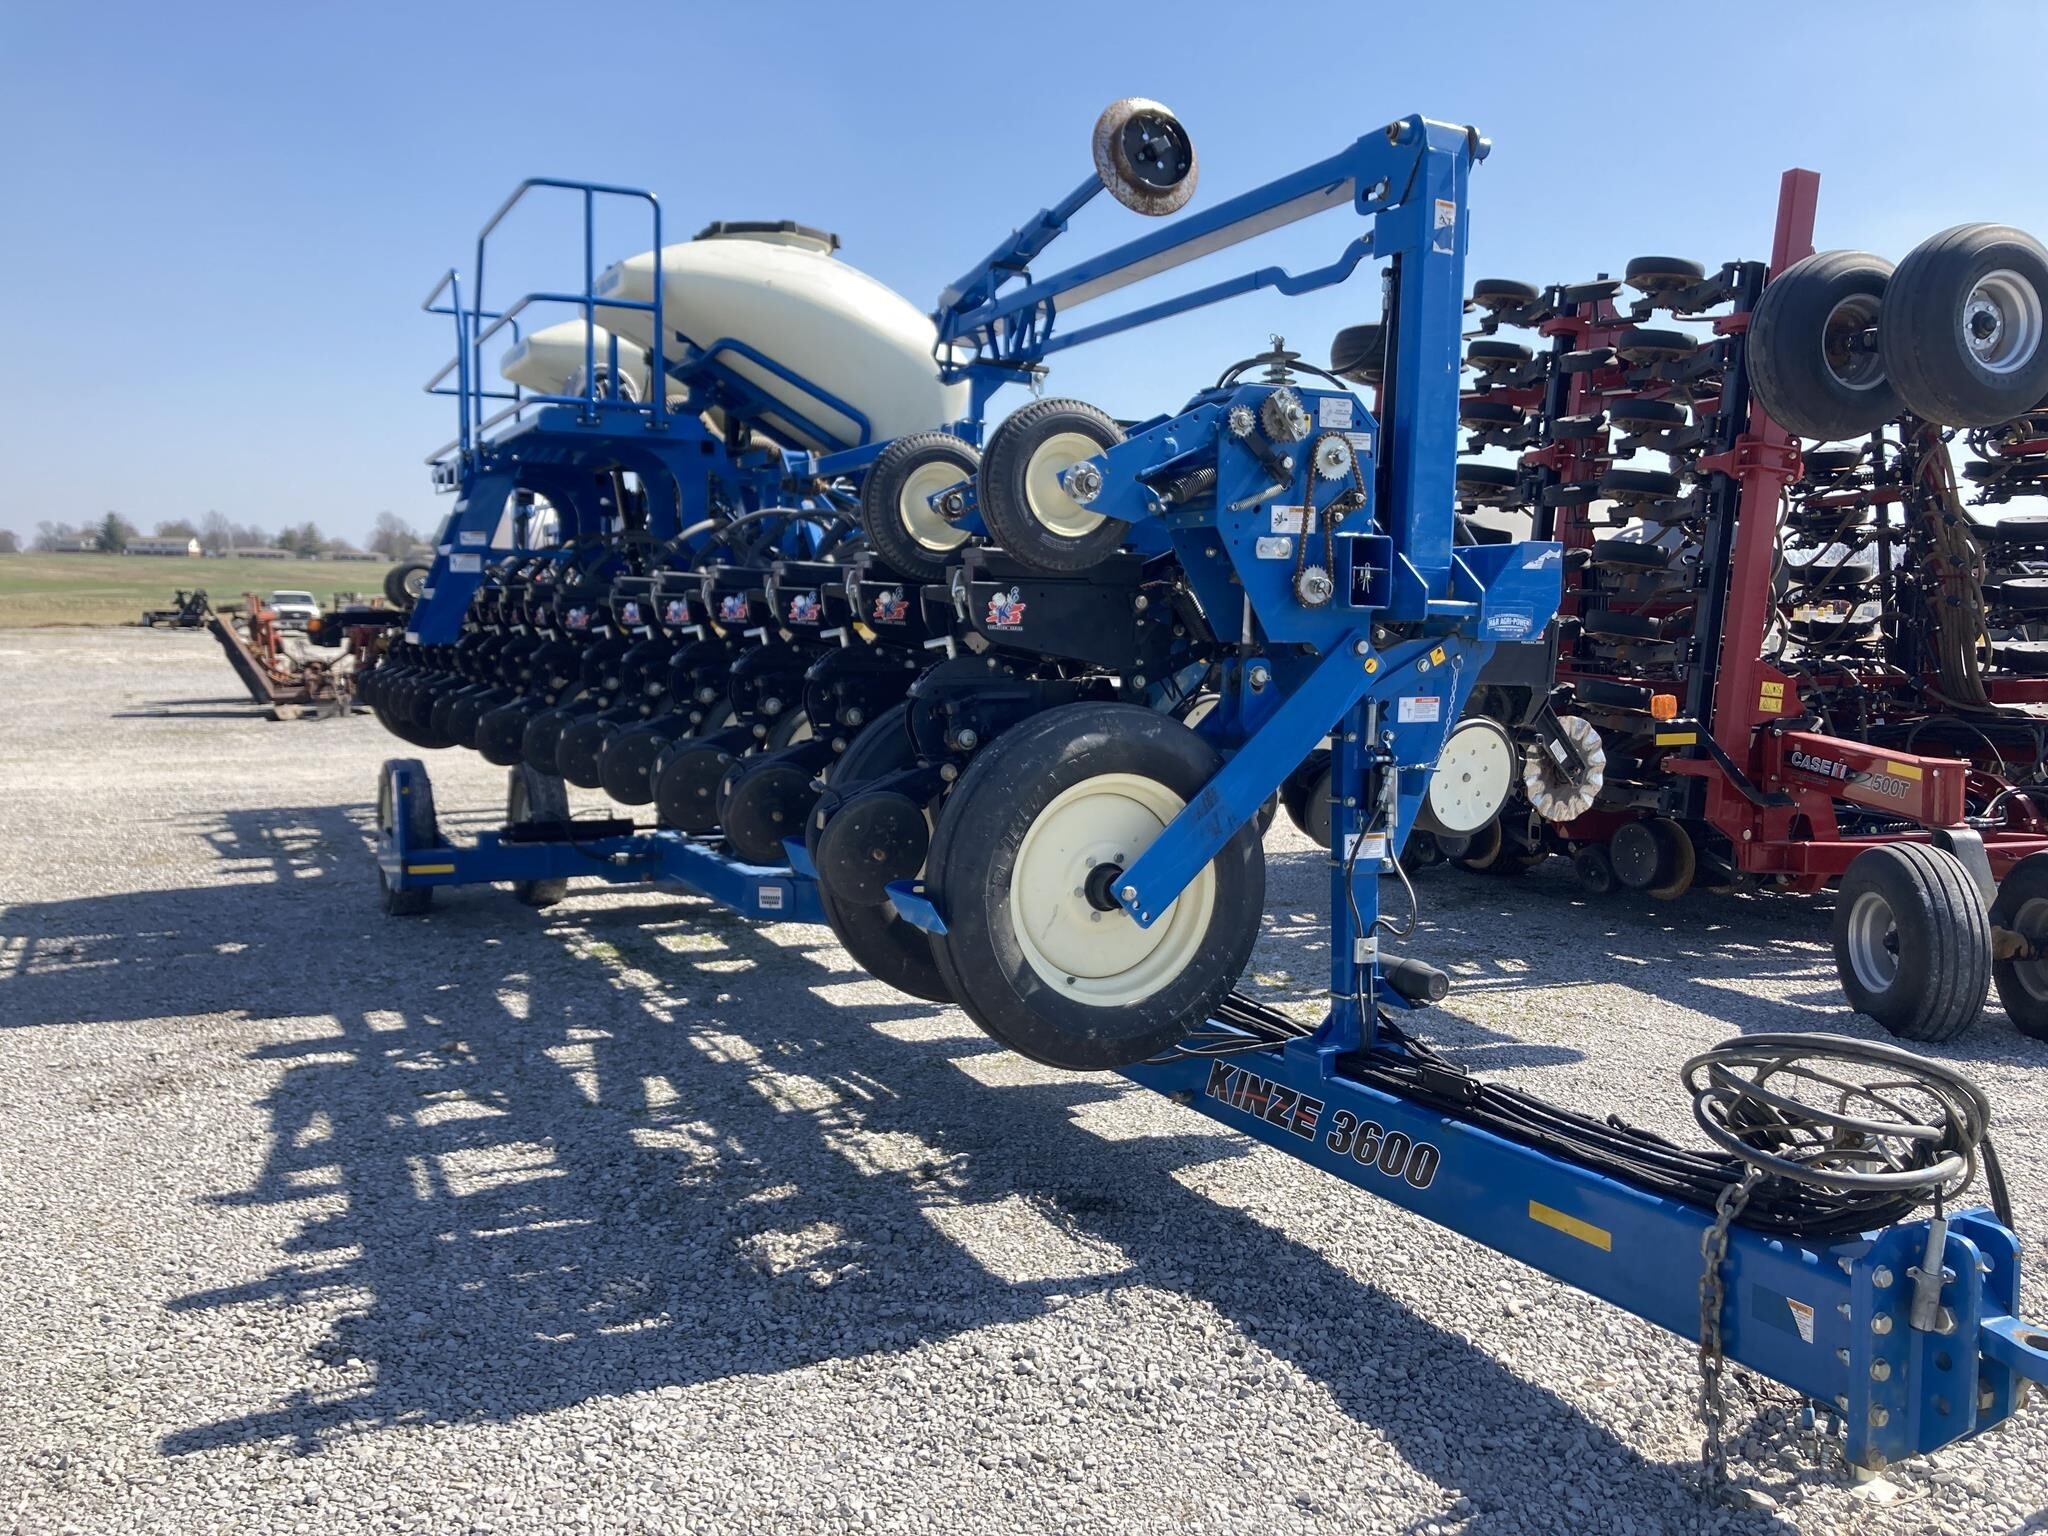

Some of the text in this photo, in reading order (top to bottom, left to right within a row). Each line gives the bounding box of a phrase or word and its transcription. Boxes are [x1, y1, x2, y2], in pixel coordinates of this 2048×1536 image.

[1791, 751, 1832, 775] CASE
[1871, 774, 1910, 799] 500T
[1205, 1058, 1441, 1189] KINZE 3600
